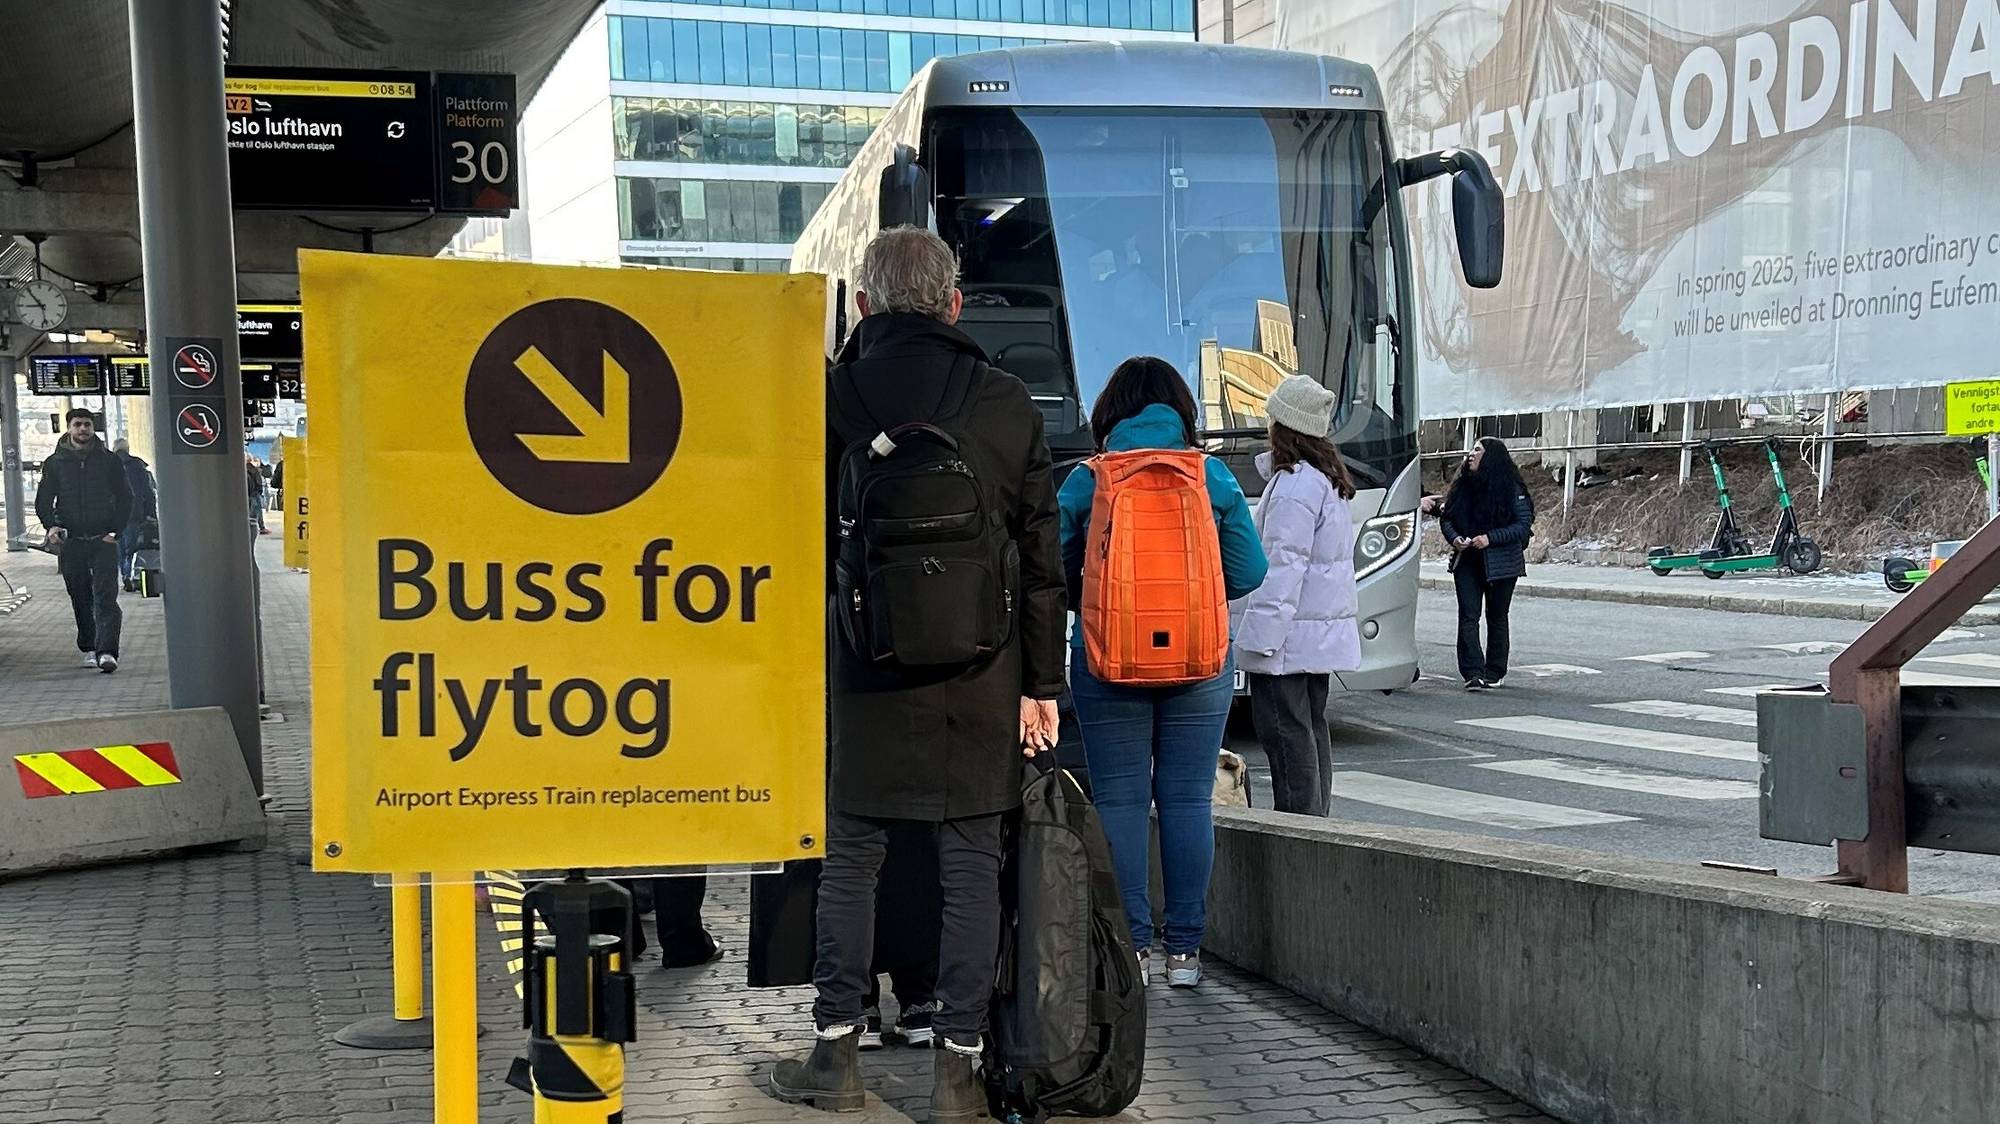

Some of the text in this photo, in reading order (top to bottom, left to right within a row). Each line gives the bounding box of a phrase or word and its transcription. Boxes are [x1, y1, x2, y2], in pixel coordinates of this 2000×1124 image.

[446, 97, 508, 111] Plattform
[266, 118, 342, 137] lufthavn
[447, 113, 504, 128] Platform
[255, 141, 272, 149] Oslo
[274, 141, 305, 149] lufthavn
[306, 142, 335, 151] stasjon
[452, 141, 509, 183] 30
[1677, 232, 2000, 303] In spring 2025, five extraordinary c
[1674, 274, 2000, 337] will be unveiled at Dronning Eufem
[281, 380, 299, 392] 32
[261, 403, 274, 414] 33
[1966, 418, 1994, 429] andre
[378, 538, 772, 622] Buss for
[373, 651, 672, 762] flytog
[376, 784, 771, 811] Airport Express Train replacement bus
